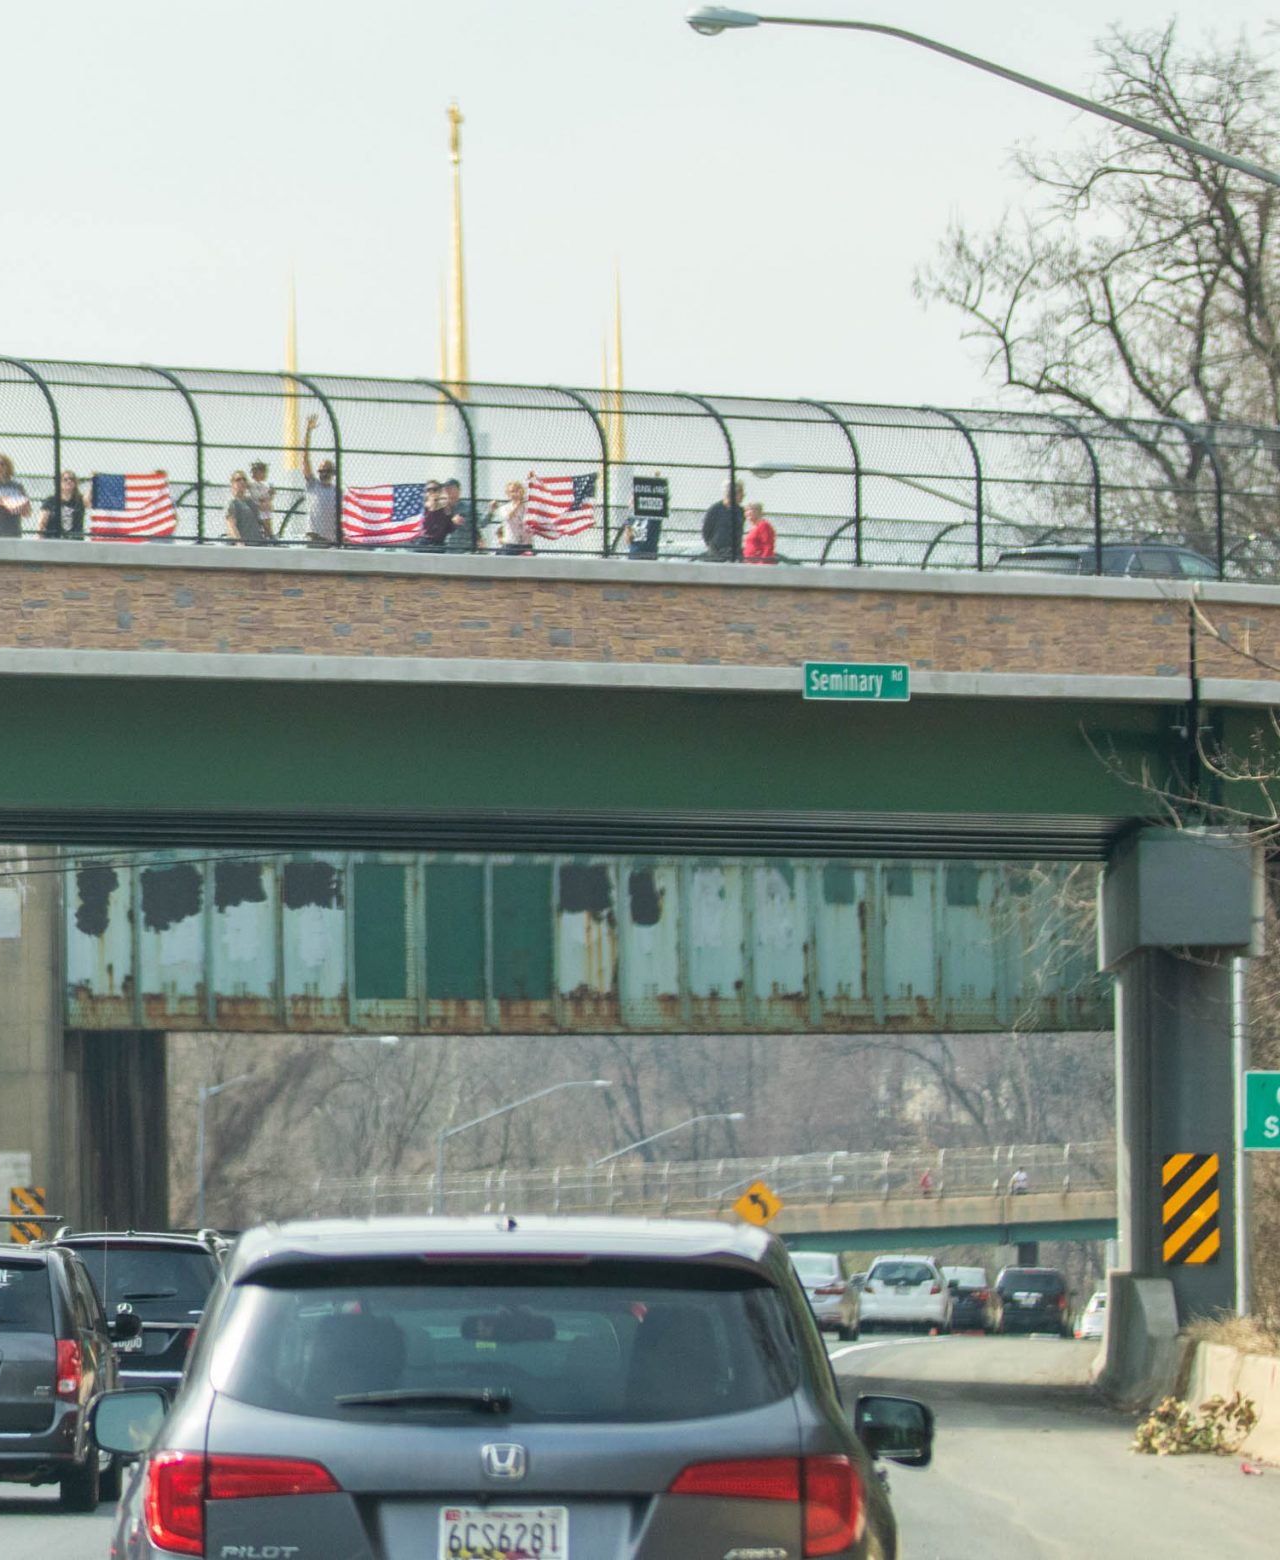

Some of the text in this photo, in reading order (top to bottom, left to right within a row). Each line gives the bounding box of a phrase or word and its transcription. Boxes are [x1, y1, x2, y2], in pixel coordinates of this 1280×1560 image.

[810, 668, 903, 698] Seminary Rd
[221, 1546, 300, 1559] PILOT
[449, 1523, 558, 1553] 6CS6281
